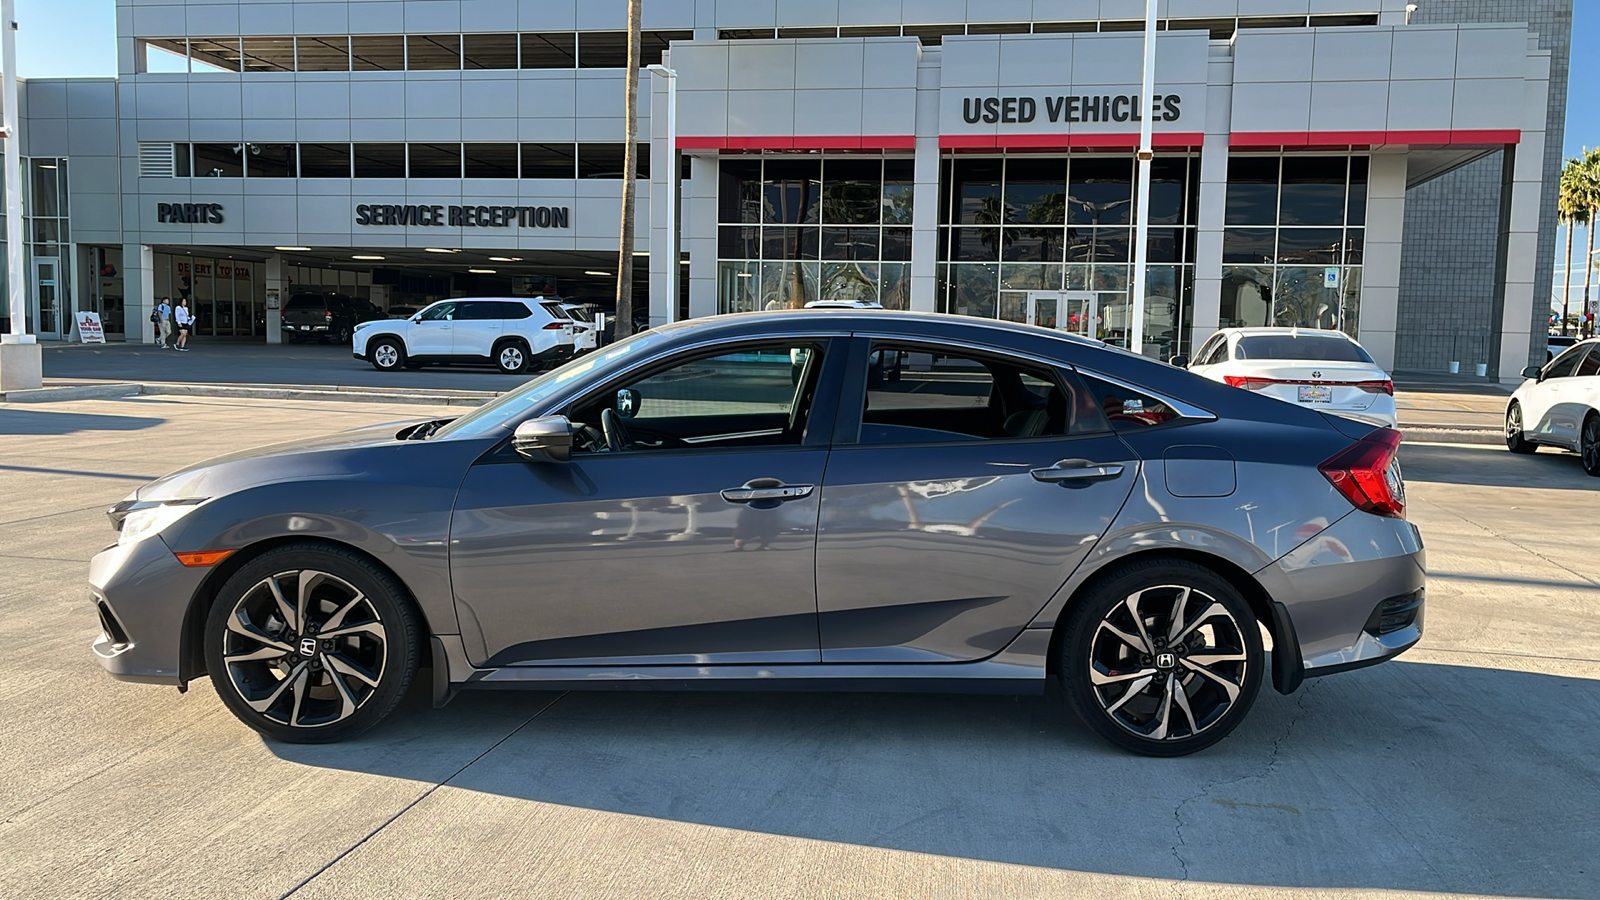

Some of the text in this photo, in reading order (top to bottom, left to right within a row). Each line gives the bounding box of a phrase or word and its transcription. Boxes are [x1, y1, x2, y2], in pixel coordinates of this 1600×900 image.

[963, 94, 1182, 124] USED VEHICLES
[157, 202, 224, 224] PARTS
[356, 204, 569, 228] SERVICE RECEPTION
[178, 262, 211, 274] DEERT
